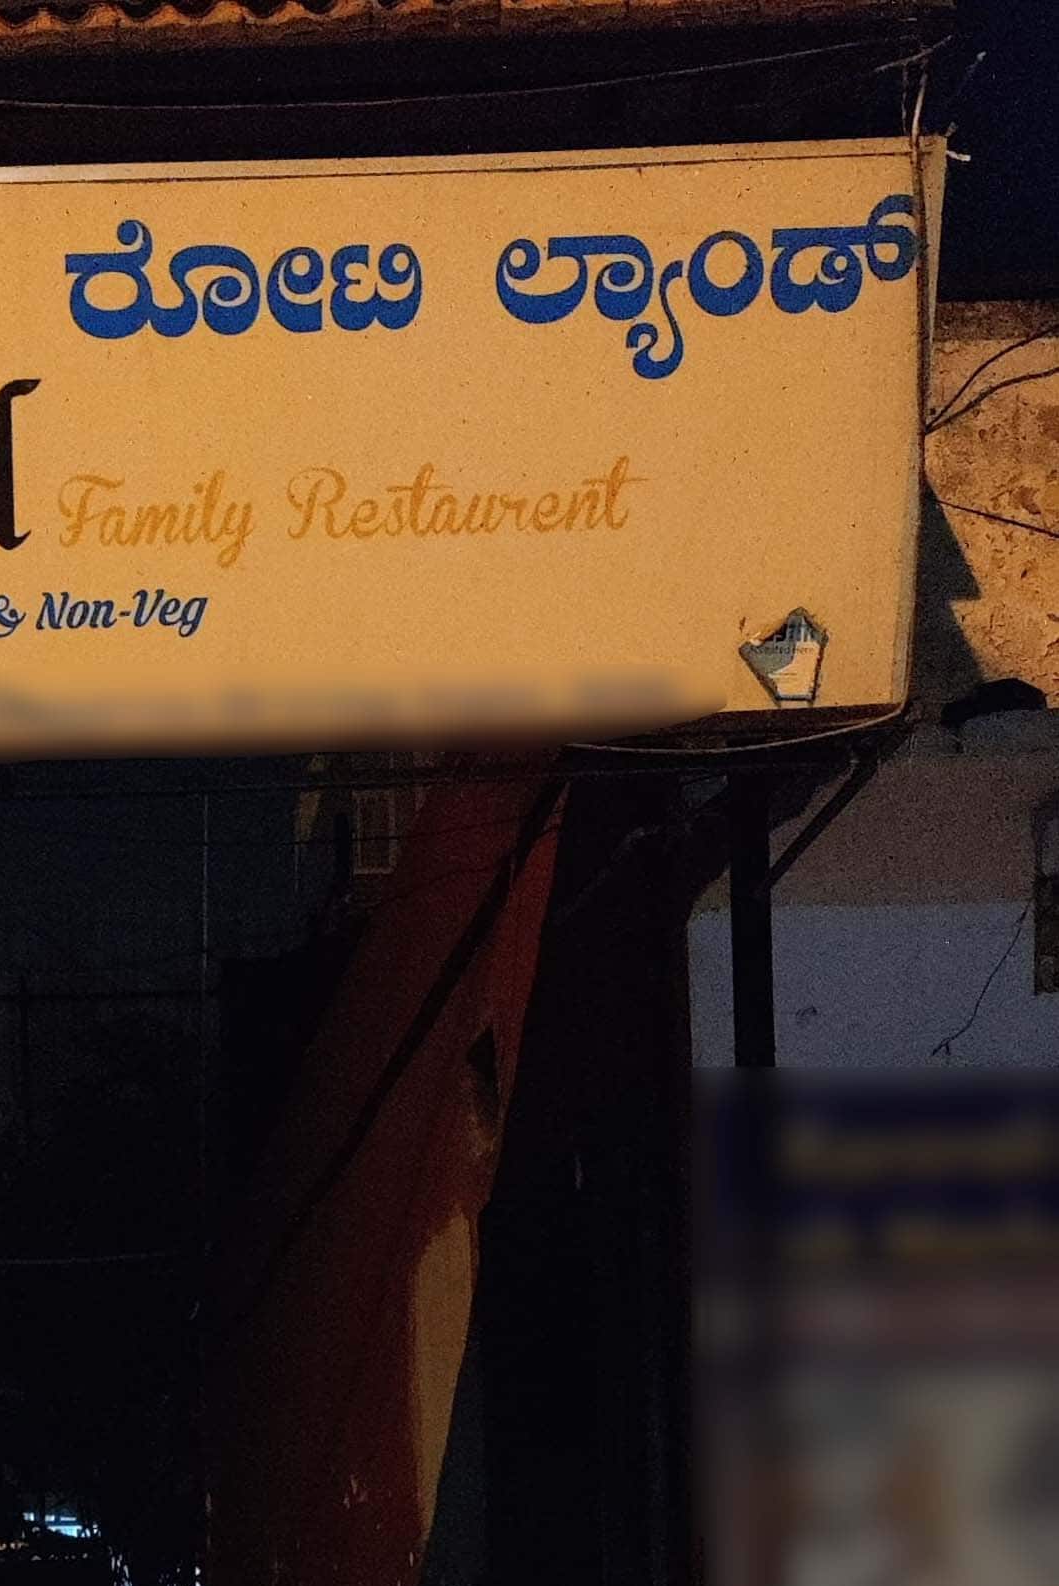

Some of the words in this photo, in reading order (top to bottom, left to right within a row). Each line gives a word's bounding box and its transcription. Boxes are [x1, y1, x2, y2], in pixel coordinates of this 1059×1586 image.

[65, 219, 423, 340] ರೋಟಿ
[495, 193, 919, 380] ಲ್ಯಾಂಡ್
[58, 468, 255, 569] Family
[286, 455, 649, 540] Restaurent
[34, 588, 210, 638] Non-Veg
